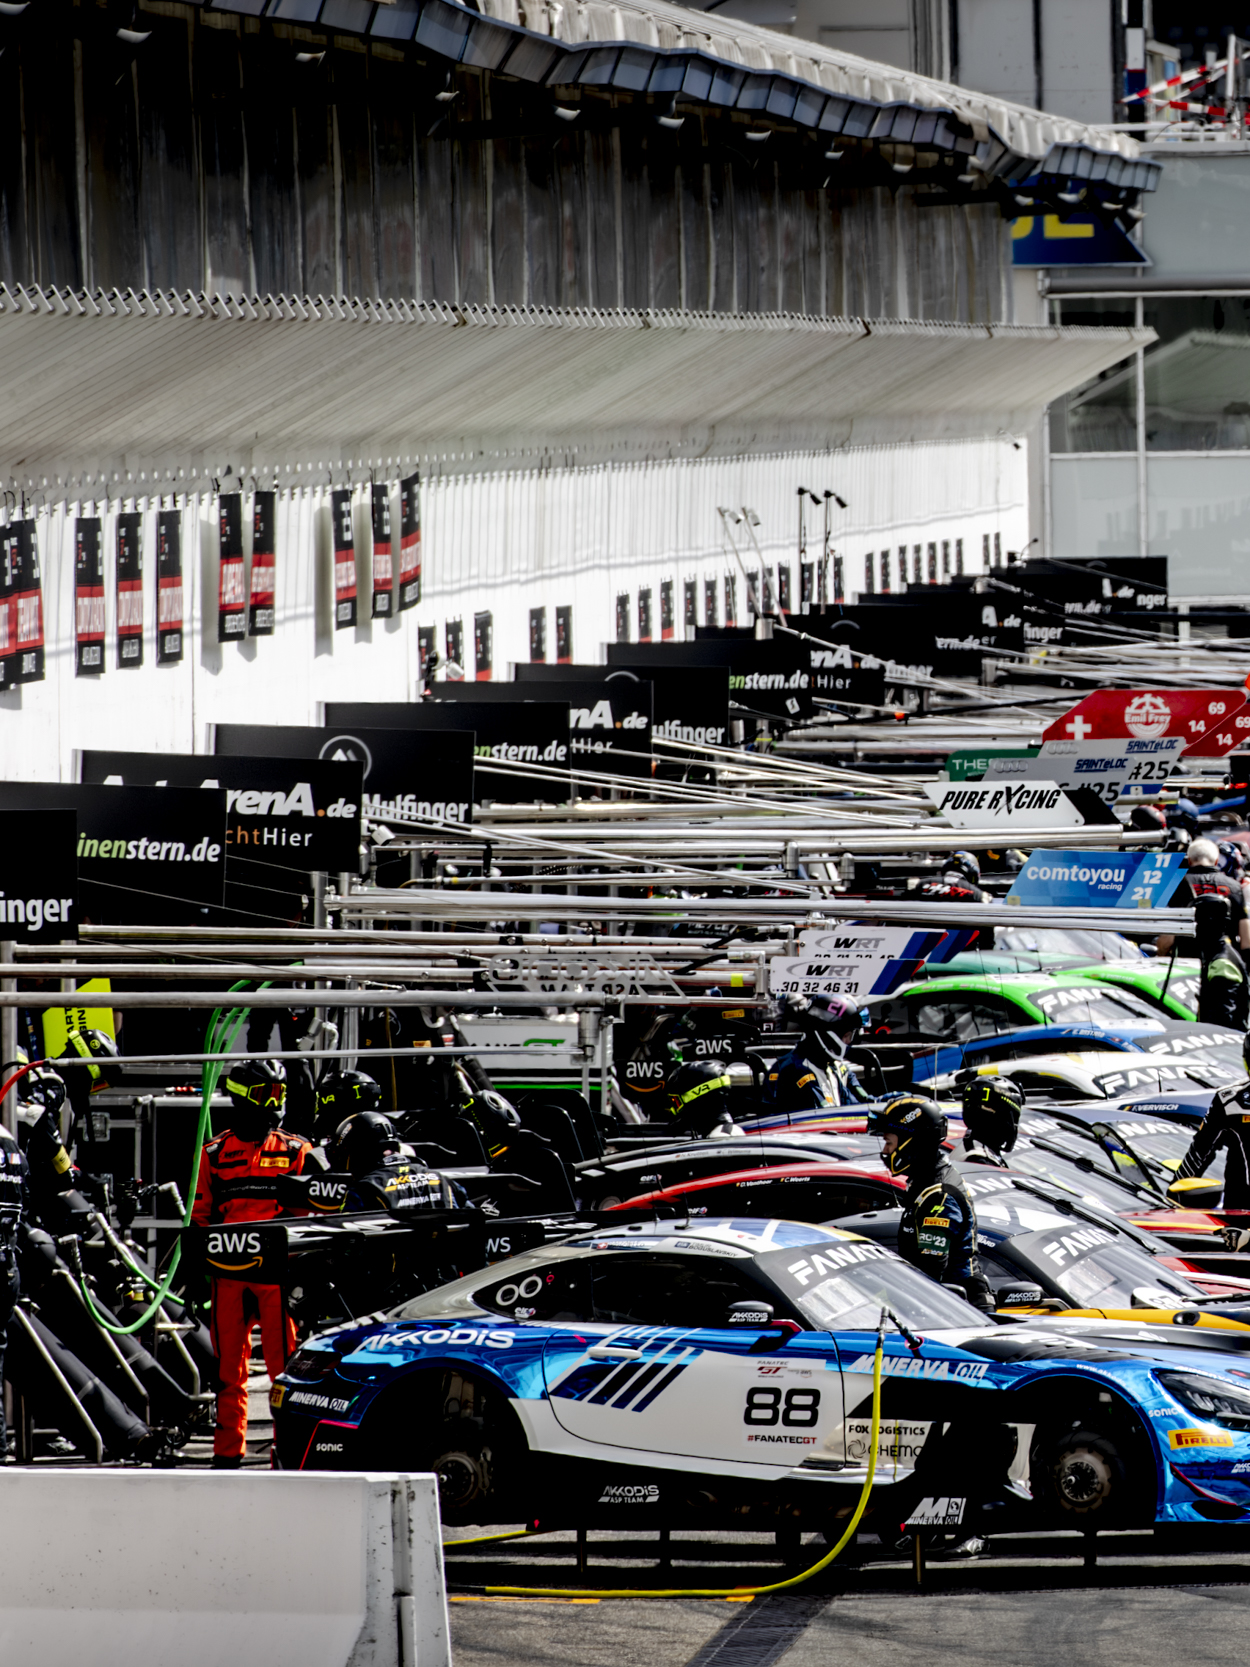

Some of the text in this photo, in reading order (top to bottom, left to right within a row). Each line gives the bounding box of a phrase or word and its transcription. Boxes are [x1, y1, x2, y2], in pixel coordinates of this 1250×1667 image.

[1208, 701, 1226, 715] 69
[1125, 713, 1171, 726] Emil Frey
[1188, 720, 1206, 733] 14
[1216, 733, 1233, 747] 14
[1128, 761, 1170, 781] #25
[939, 790, 990, 811] PURE
[1155, 854, 1173, 868] 11
[1027, 864, 1162, 886] comtoyou 12
[1098, 883, 1153, 900] racing 21
[834, 937, 886, 949] WRT
[806, 965, 860, 976] WRT
[781, 981, 860, 993] 30 32 46 31
[696, 1039, 733, 1055] aws
[626, 1060, 664, 1078] aws
[308, 1180, 348, 1198] aws
[207, 1232, 261, 1254] aws
[352, 1329, 516, 1354] AKKODIS
[954, 1362, 990, 1382] OIL
[289, 1391, 329, 1408] MINERVA
[743, 1387, 821, 1428] 88
[848, 1425, 869, 1434] FOX
[747, 1434, 818, 1445] #FANATECGT
[1175, 1431, 1228, 1446] PIRELLI
[603, 1485, 660, 1497] AKKODIS
[905, 1516, 943, 1525] MINERVA
